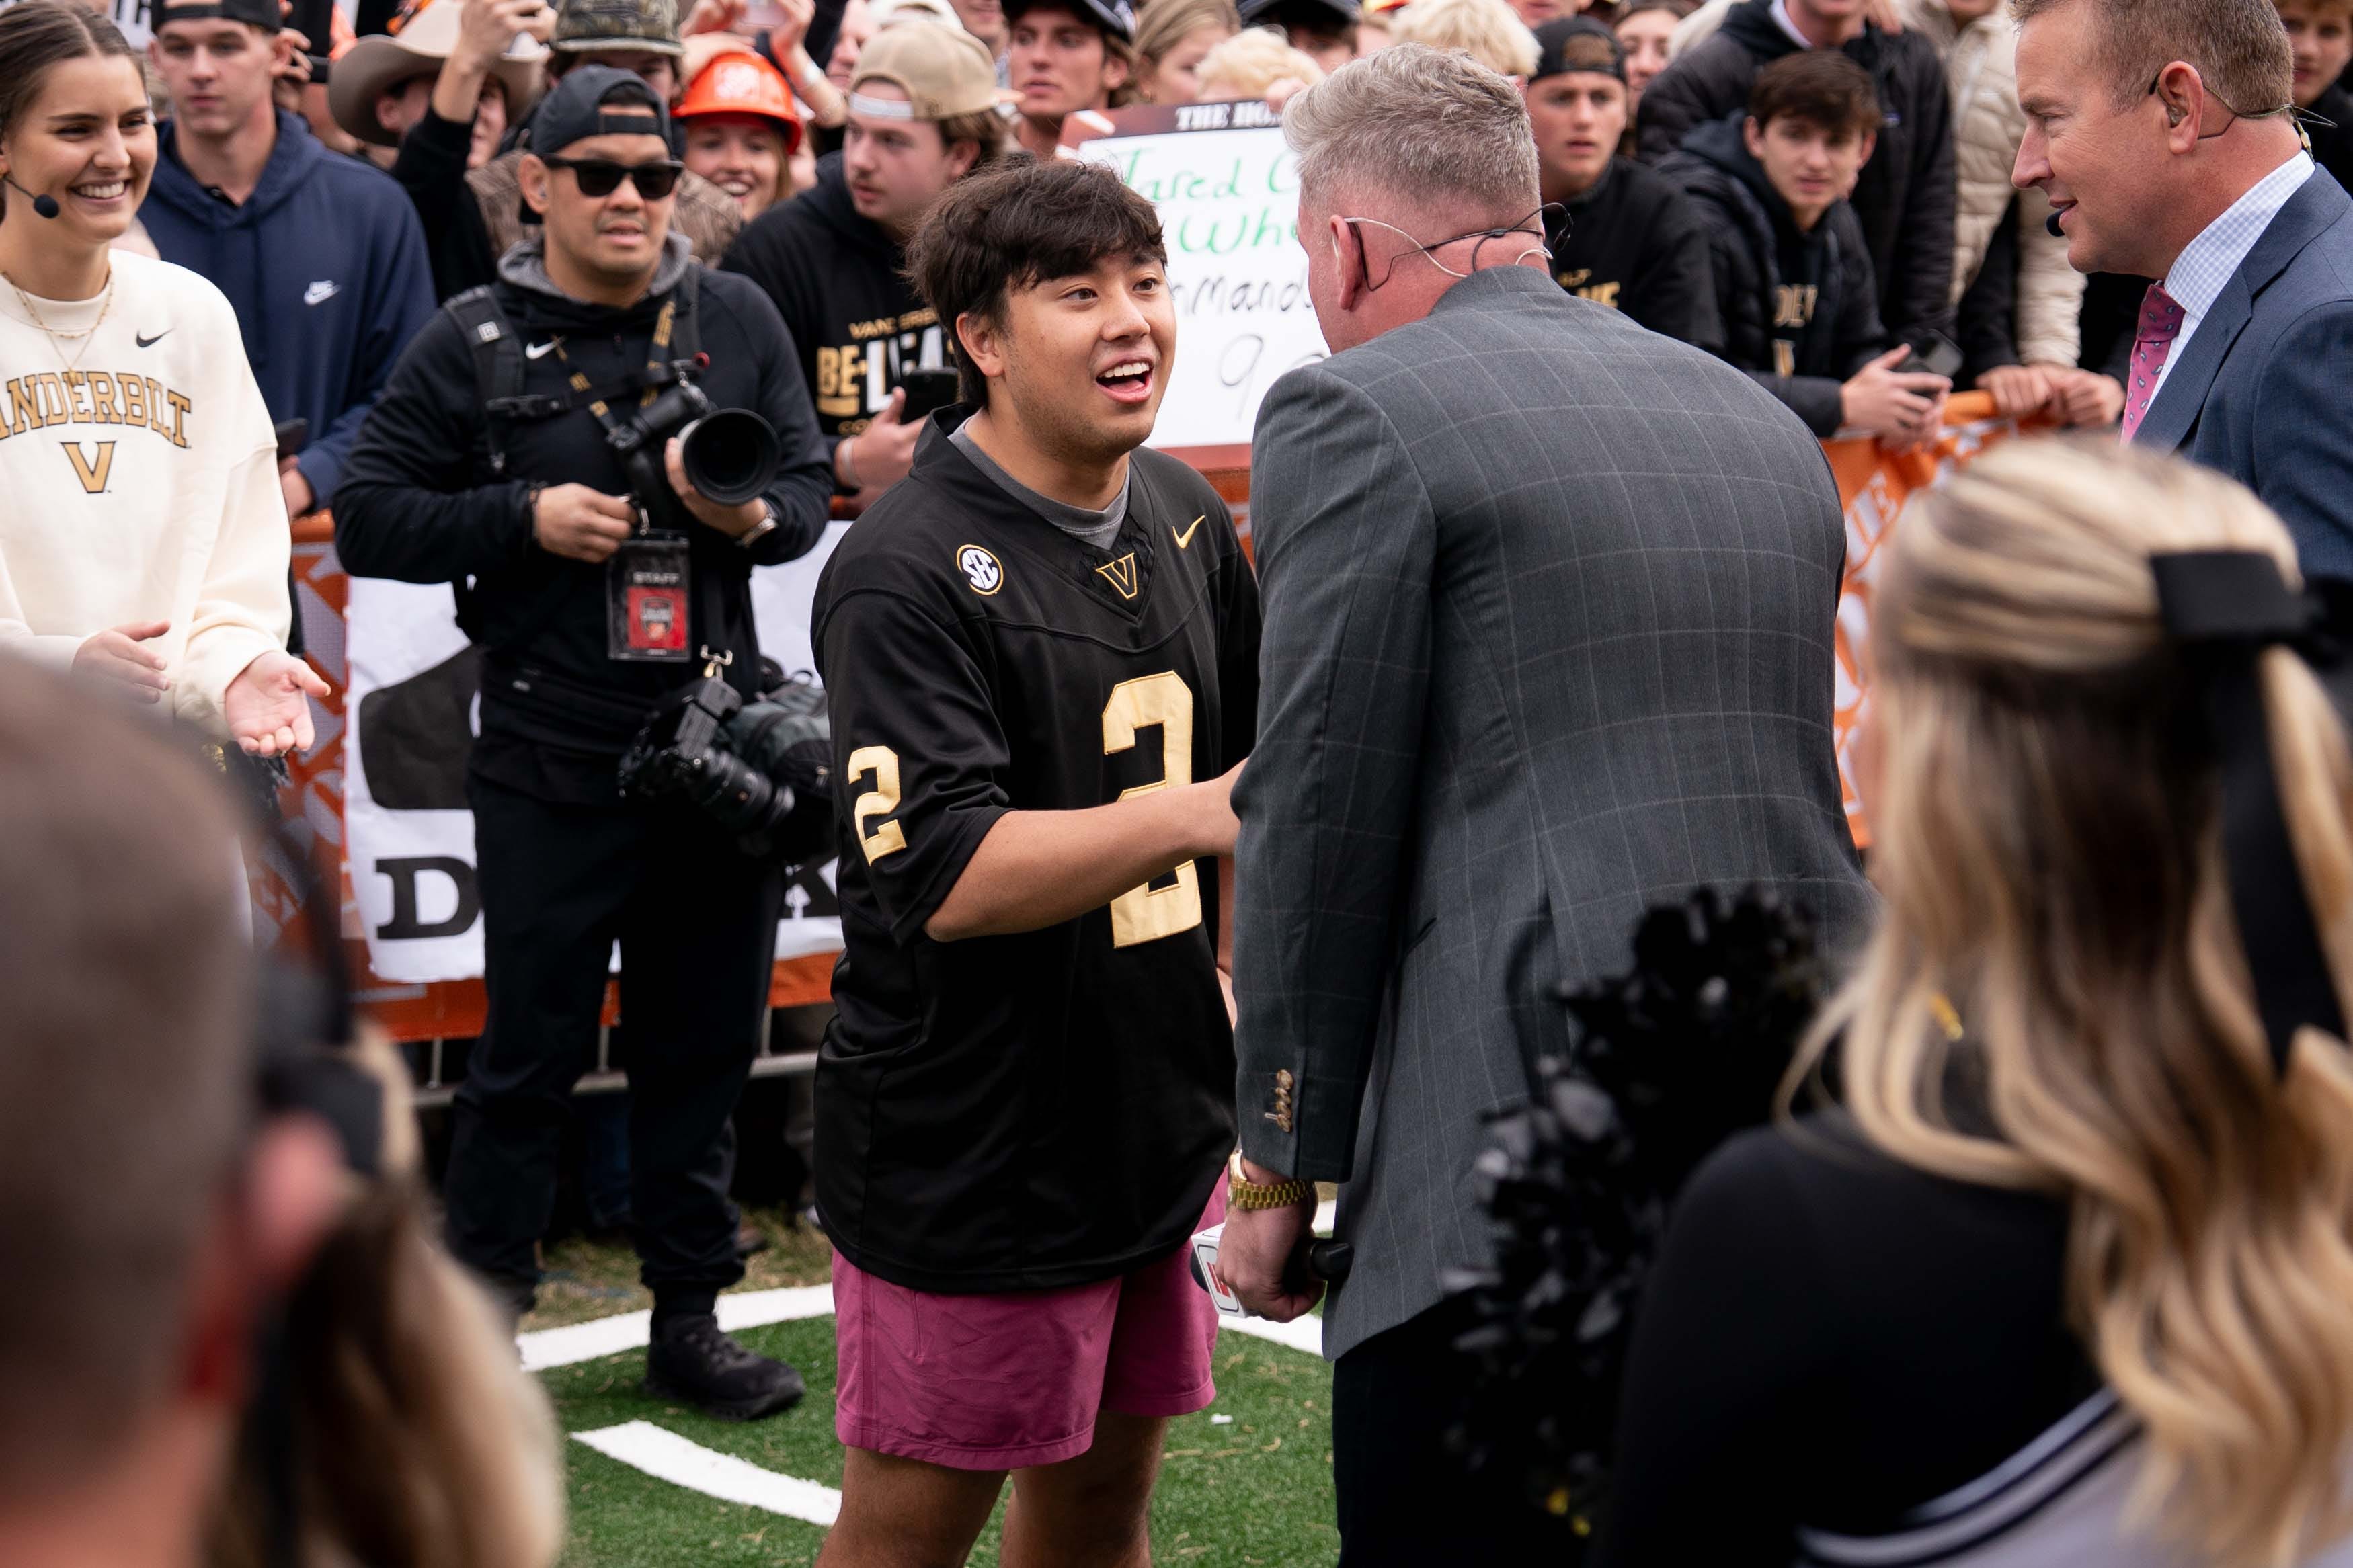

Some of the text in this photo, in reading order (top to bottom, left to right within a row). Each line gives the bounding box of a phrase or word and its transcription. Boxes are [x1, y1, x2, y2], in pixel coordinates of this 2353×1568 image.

[1175, 104, 1230, 130] THE
[0, 370, 191, 448] NDERBILT
[59, 440, 116, 493] V
[633, 572, 679, 585] STAFF
[961, 548, 998, 590] SEC
[1095, 552, 1138, 600] V
[848, 745, 908, 867] 2
[1103, 671, 1203, 949] 2
